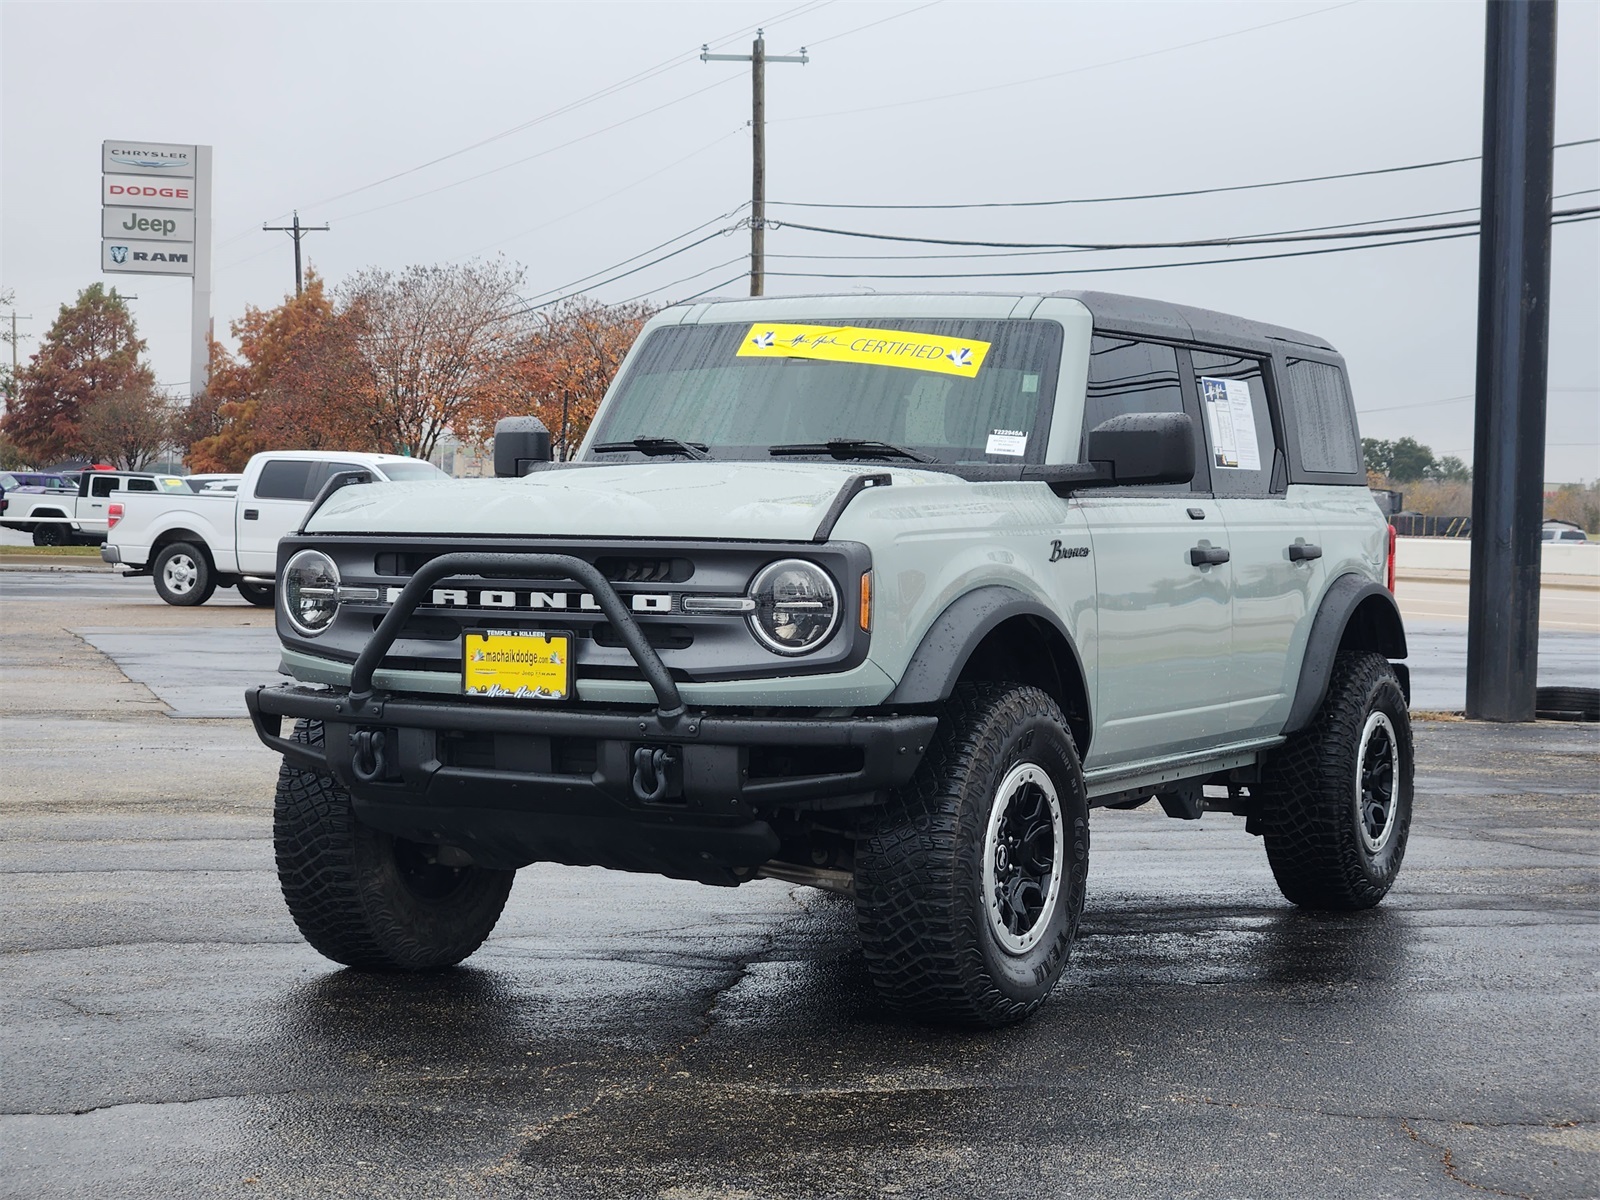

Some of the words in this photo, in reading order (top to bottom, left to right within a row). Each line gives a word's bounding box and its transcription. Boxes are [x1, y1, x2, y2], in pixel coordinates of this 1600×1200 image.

[111, 149, 187, 159] CHRYSLER
[110, 185, 189, 198] DODGE
[122, 213, 176, 236] Jeep
[133, 251, 188, 263] RAM
[850, 338, 945, 360] CERTIFIED
[1049, 539, 1090, 563] Bronco
[485, 649, 549, 667] machaikdodge.com
